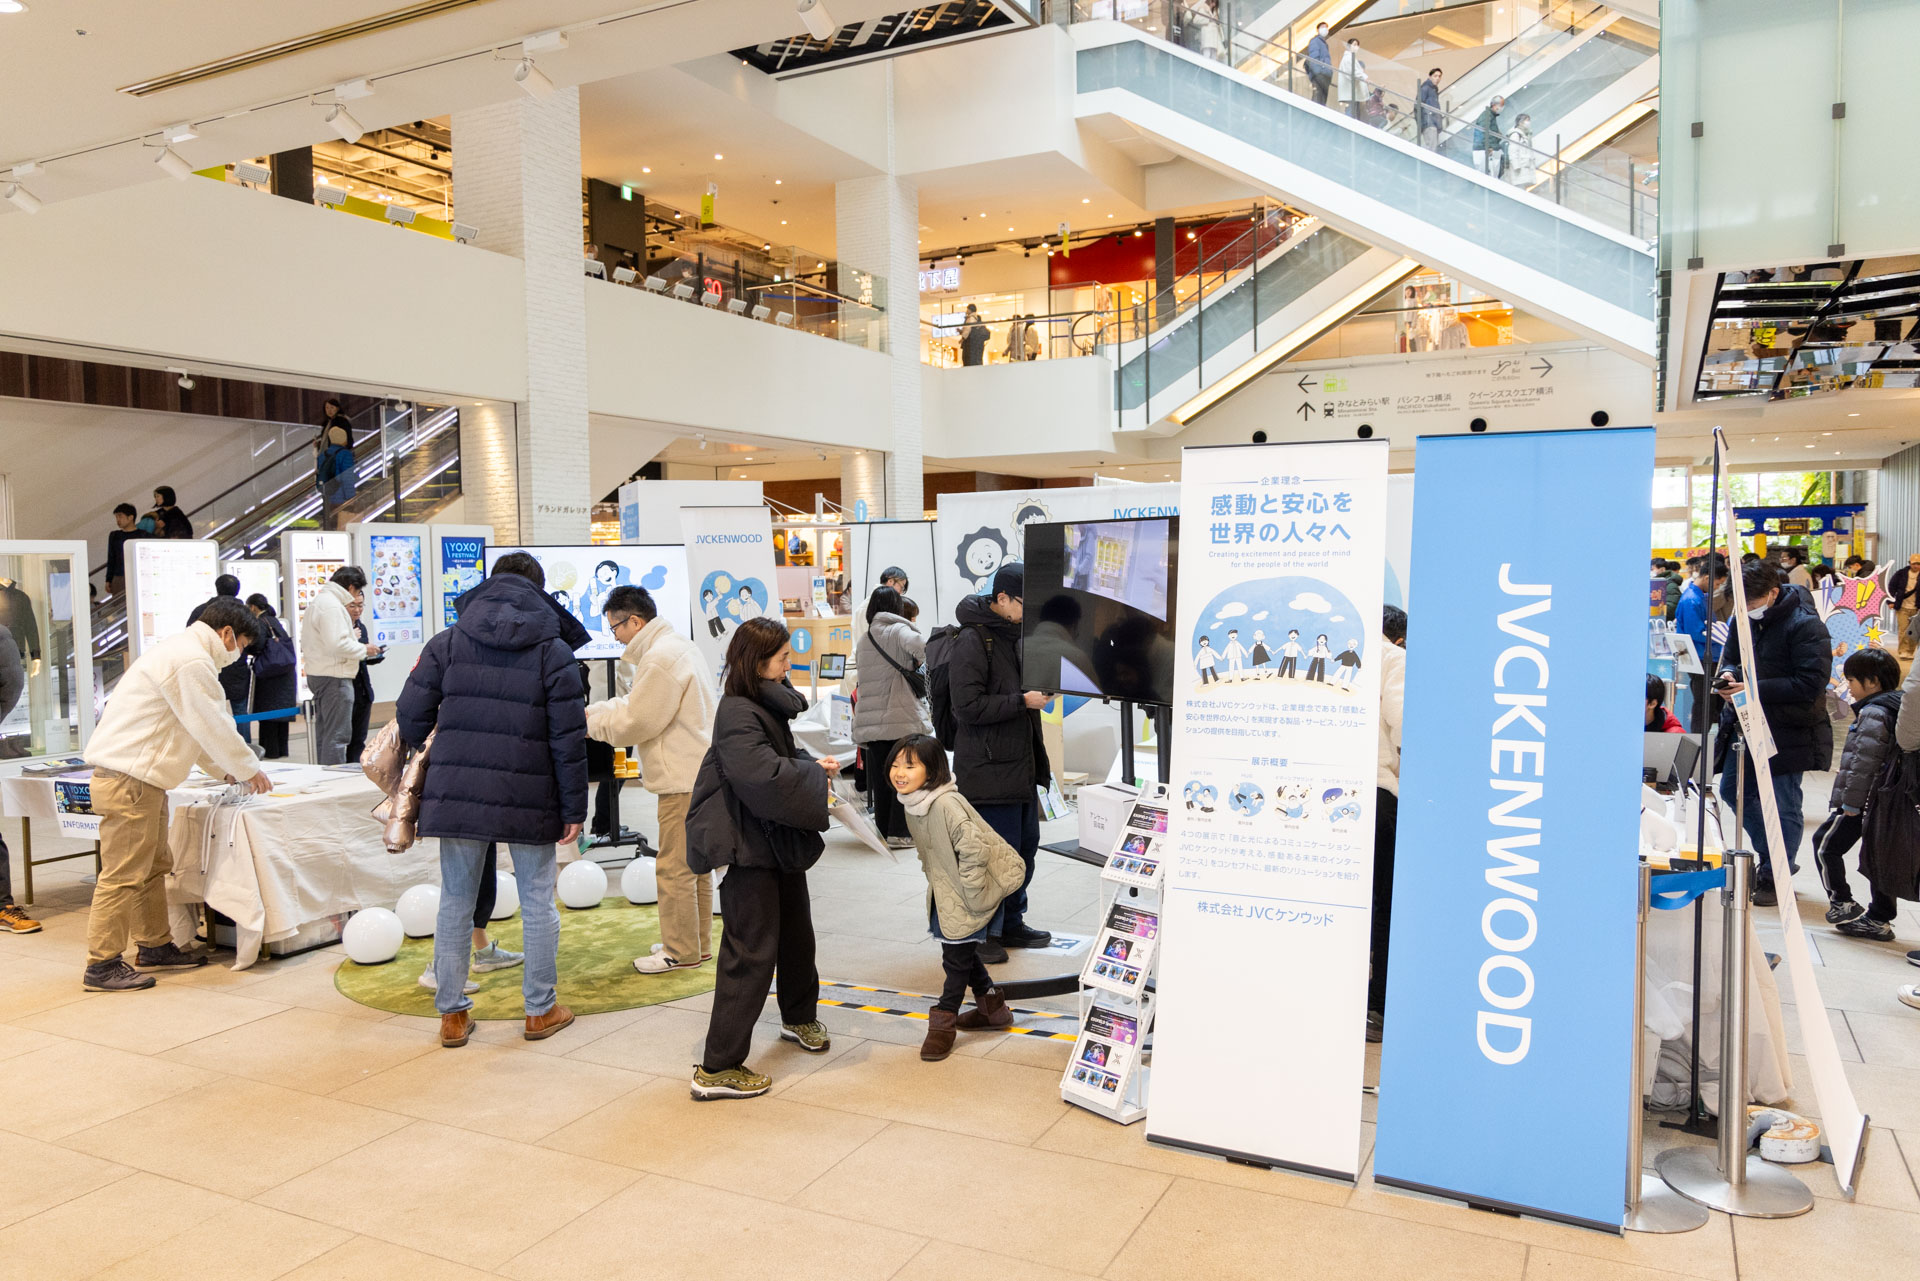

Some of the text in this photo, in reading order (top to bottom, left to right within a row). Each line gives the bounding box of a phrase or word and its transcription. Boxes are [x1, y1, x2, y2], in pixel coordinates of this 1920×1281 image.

[1397, 393, 1452, 404] パシフィコ横浜
[1469, 386, 1553, 400] クイーンズスクエア横浜
[1337, 397, 1390, 408] みなとみらい駅
[1260, 475, 1301, 486] 企業理念
[537, 503, 587, 514] グランドガレリア
[1211, 491, 1353, 517] 感動と安心を
[1209, 520, 1352, 545] 世界の人々へ
[695, 533, 763, 545] JVCKENWOOD
[449, 542, 477, 552] YOXO
[1208, 549, 1351, 559] Creating excitement and peace of mind
[1230, 560, 1330, 569] for the people of the world
[1251, 756, 1289, 768] 展示概要
[1475, 562, 1553, 1066] JVCKENWOOD
[1178, 870, 1201, 880] します。
